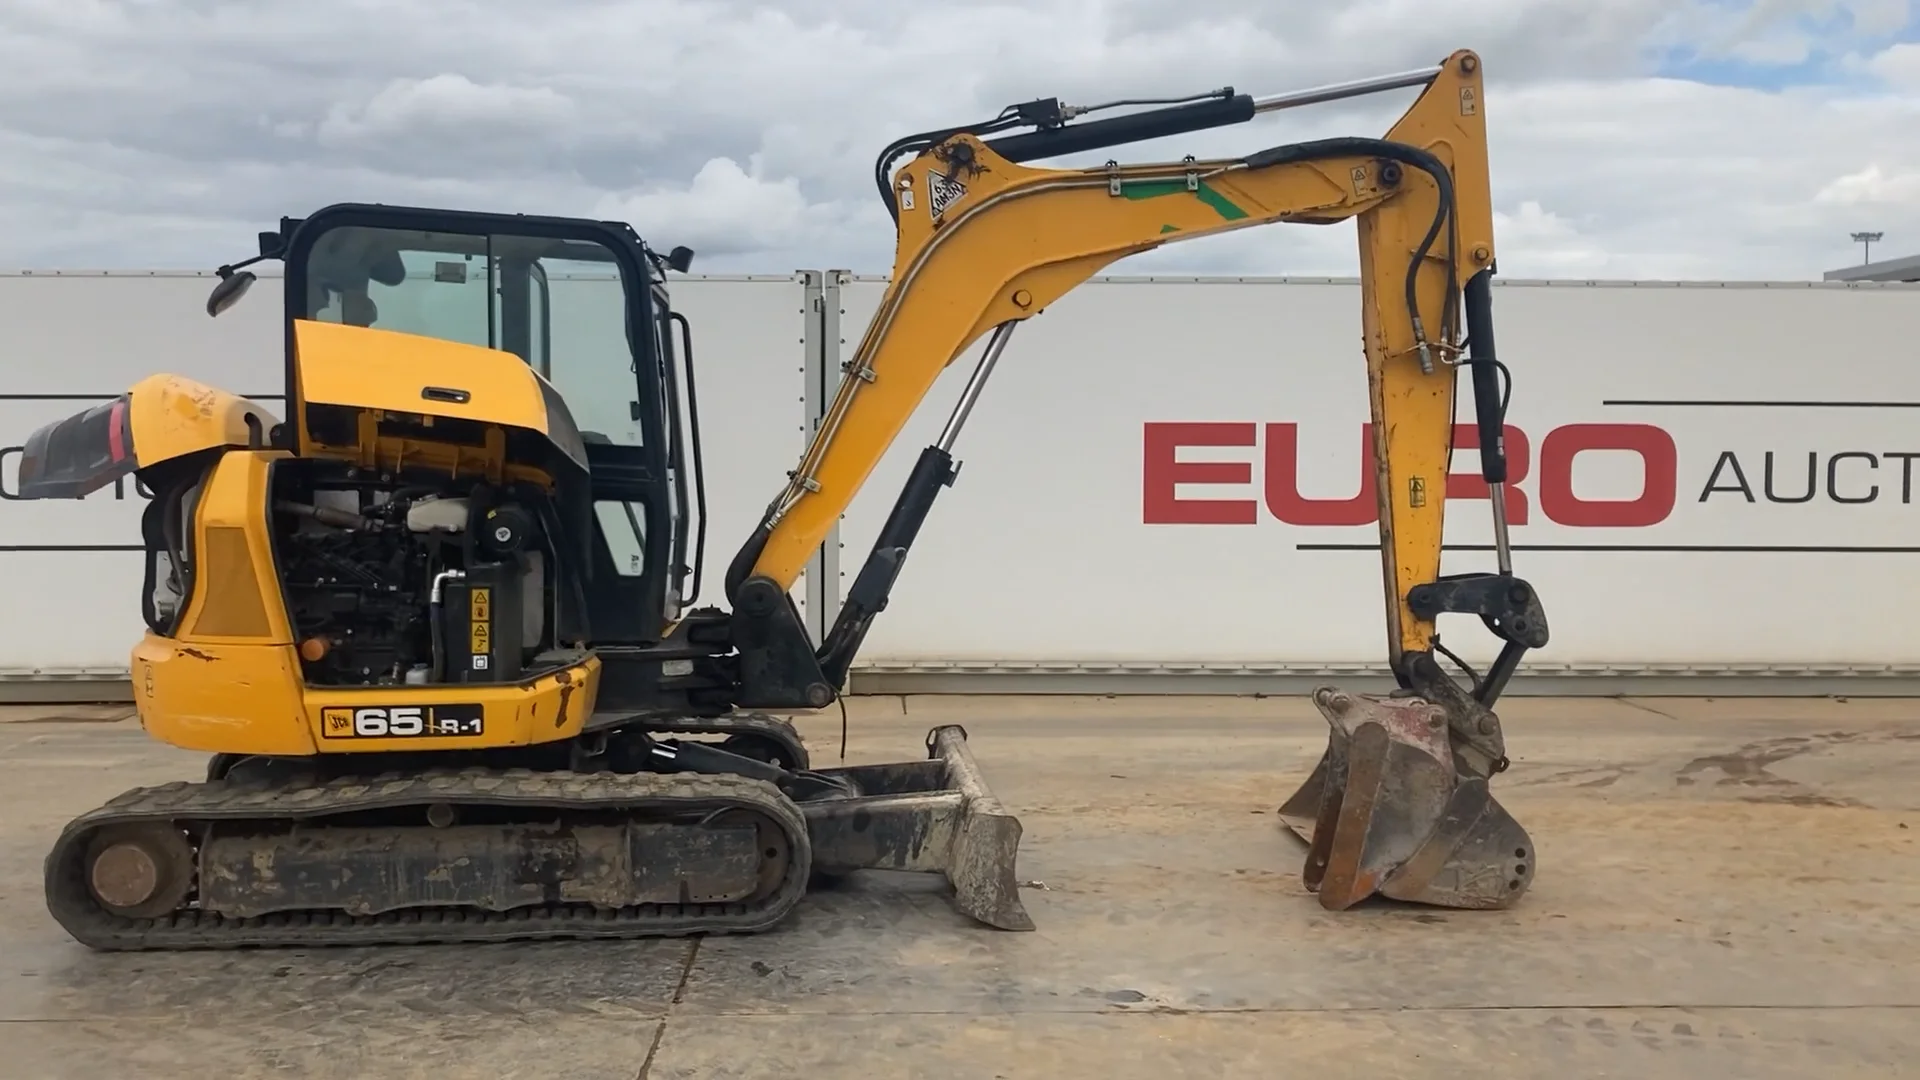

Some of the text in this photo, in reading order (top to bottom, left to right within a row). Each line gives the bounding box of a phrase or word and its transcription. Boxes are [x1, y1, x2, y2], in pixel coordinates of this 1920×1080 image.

[1144, 422, 1920, 527] EURO AUCT
[355, 708, 424, 736] 65
